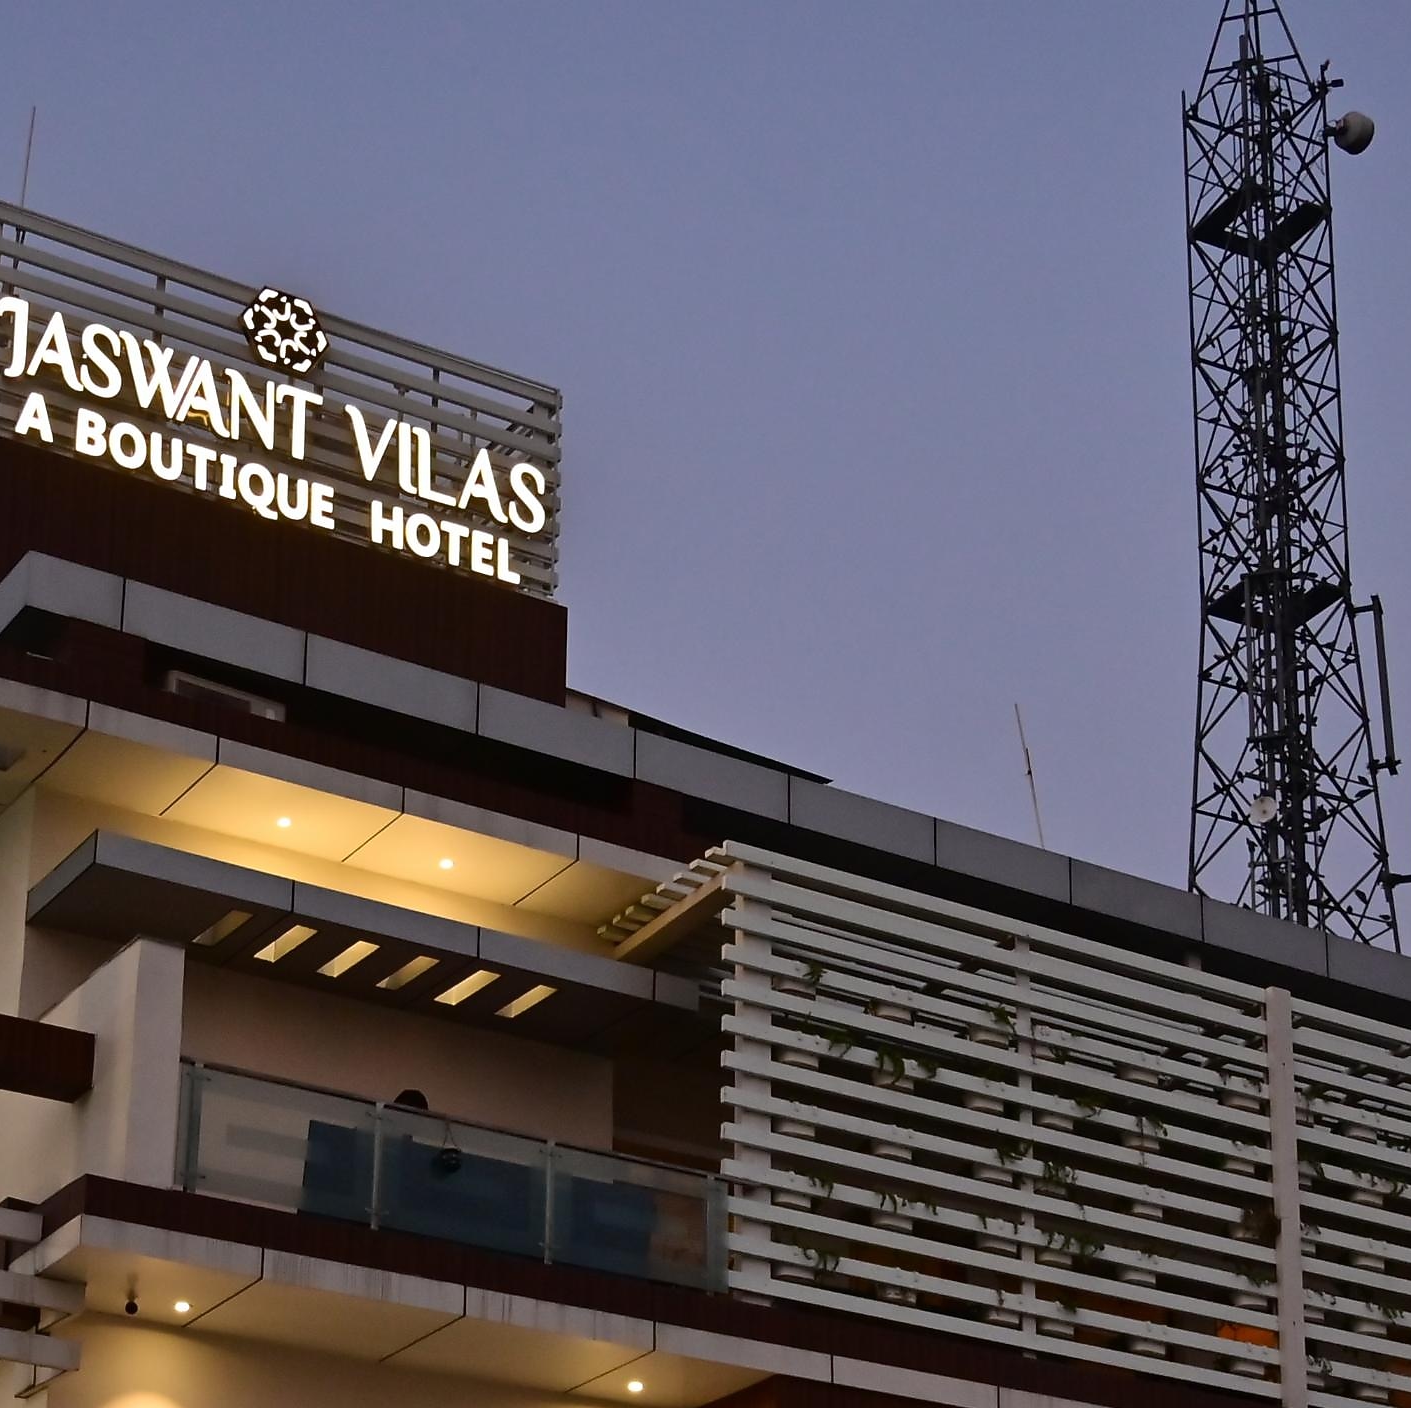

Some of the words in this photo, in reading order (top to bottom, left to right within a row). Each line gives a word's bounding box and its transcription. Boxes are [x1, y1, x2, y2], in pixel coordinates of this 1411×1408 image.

[15, 392, 54, 443] A
[75, 407, 335, 530] BOUTIQUE
[371, 500, 521, 585] HOTEL
[344, 404, 546, 533] VILAS
